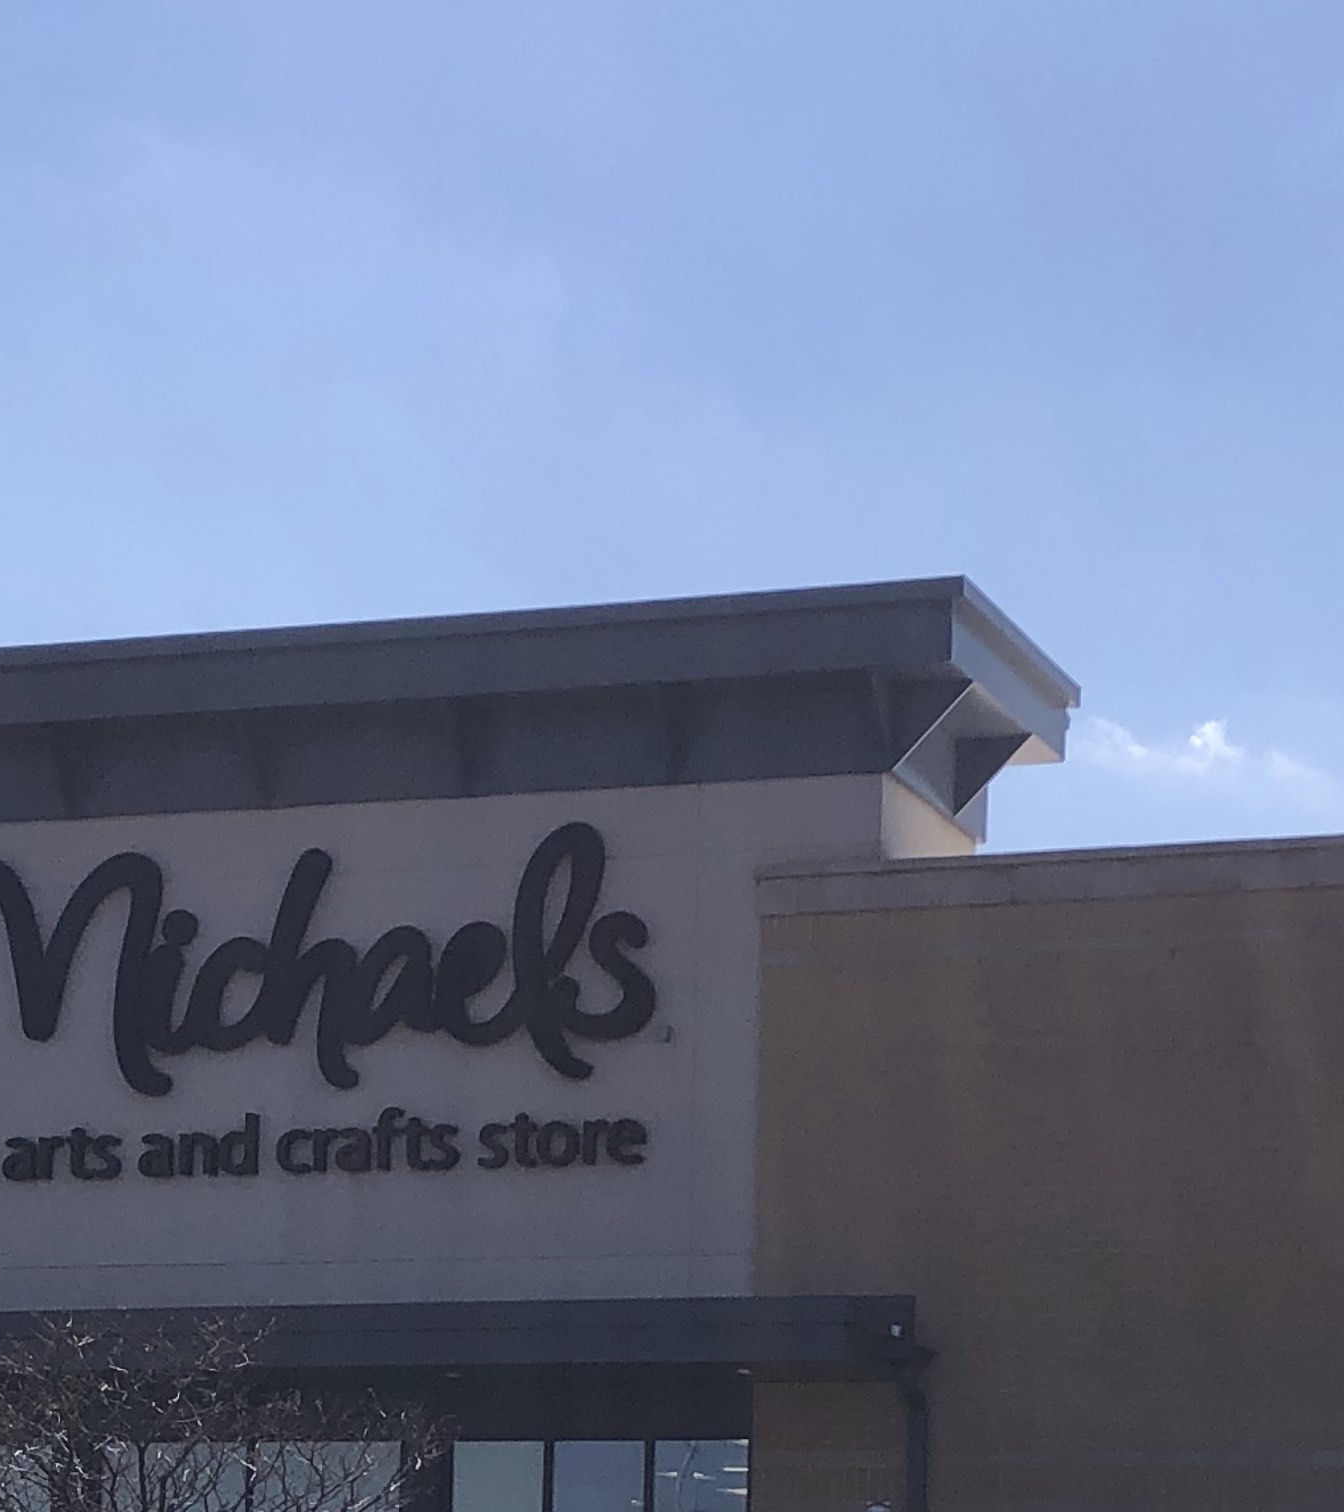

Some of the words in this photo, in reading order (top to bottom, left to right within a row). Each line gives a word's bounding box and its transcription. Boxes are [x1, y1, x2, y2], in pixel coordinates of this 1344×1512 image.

[1, 1126, 123, 1181] arts
[137, 1112, 260, 1177] and
[275, 1106, 461, 1174] crafts
[477, 1112, 647, 1168] store
